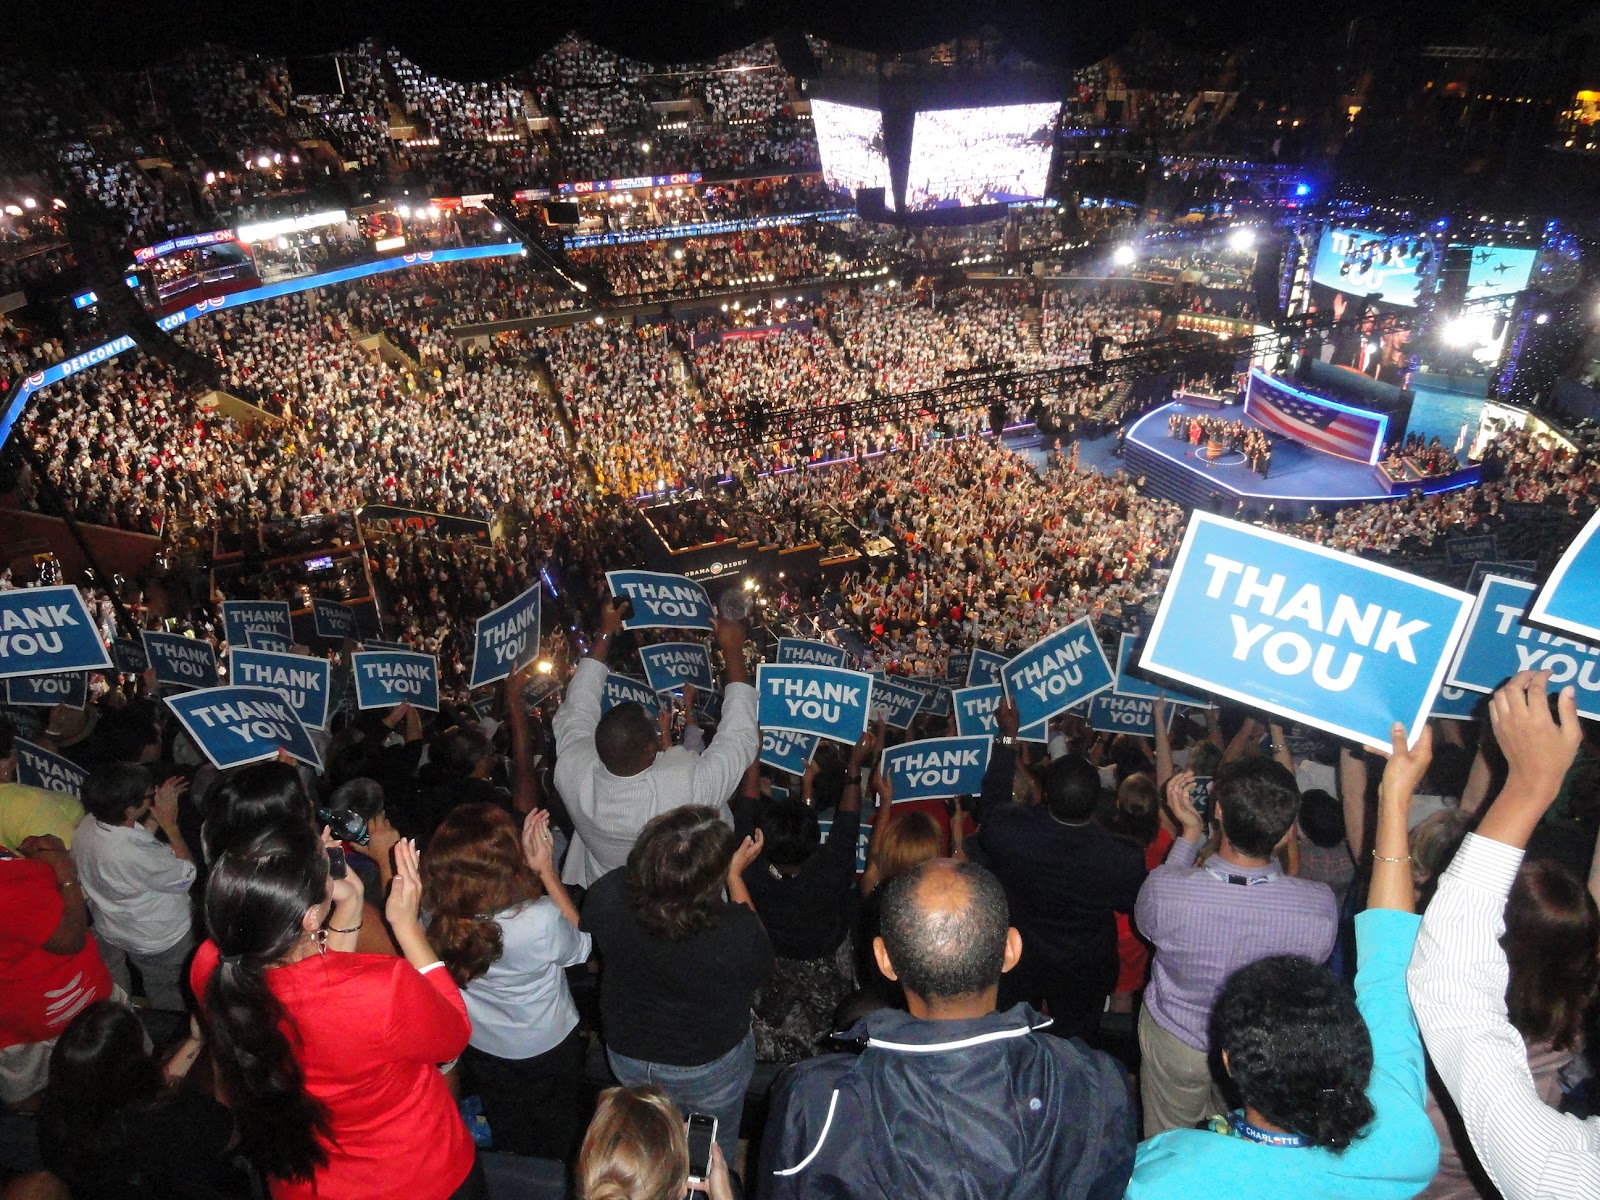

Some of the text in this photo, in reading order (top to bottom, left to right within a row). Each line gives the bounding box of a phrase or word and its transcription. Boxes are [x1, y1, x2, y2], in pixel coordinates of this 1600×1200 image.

[574, 182, 593, 192] CNN
[670, 173, 688, 184] CNN
[685, 568, 710, 577] OBAMA
[723, 559, 748, 569] BIDEN
[620, 583, 708, 607] THANK
[230, 610, 286, 624] THANK
[644, 600, 698, 617] YOU
[1204, 553, 1432, 665] THANK
[483, 602, 536, 648] THANK
[150, 642, 211, 667] THANK
[494, 632, 527, 665] YOU
[784, 647, 838, 667] THANK
[1230, 613, 1364, 692] YOU
[168, 659, 204, 678] YOU
[649, 651, 704, 667] THANK
[1011, 635, 1092, 690] THANK
[239, 663, 321, 692] THANK
[362, 663, 432, 681] THANK
[665, 663, 699, 678] YOU
[29, 679, 71, 694] YOU
[379, 679, 421, 695] YOU
[767, 678, 860, 707] THANK
[1031, 664, 1083, 703] YOU
[189, 700, 295, 728] THANK
[785, 698, 841, 723] YOU
[1099, 697, 1153, 713] THAN
[1109, 711, 1150, 726] YOU
[228, 721, 293, 743] YOU
[762, 736, 791, 756] OU
[891, 749, 981, 773] THANK
[905, 769, 960, 788] YOU
